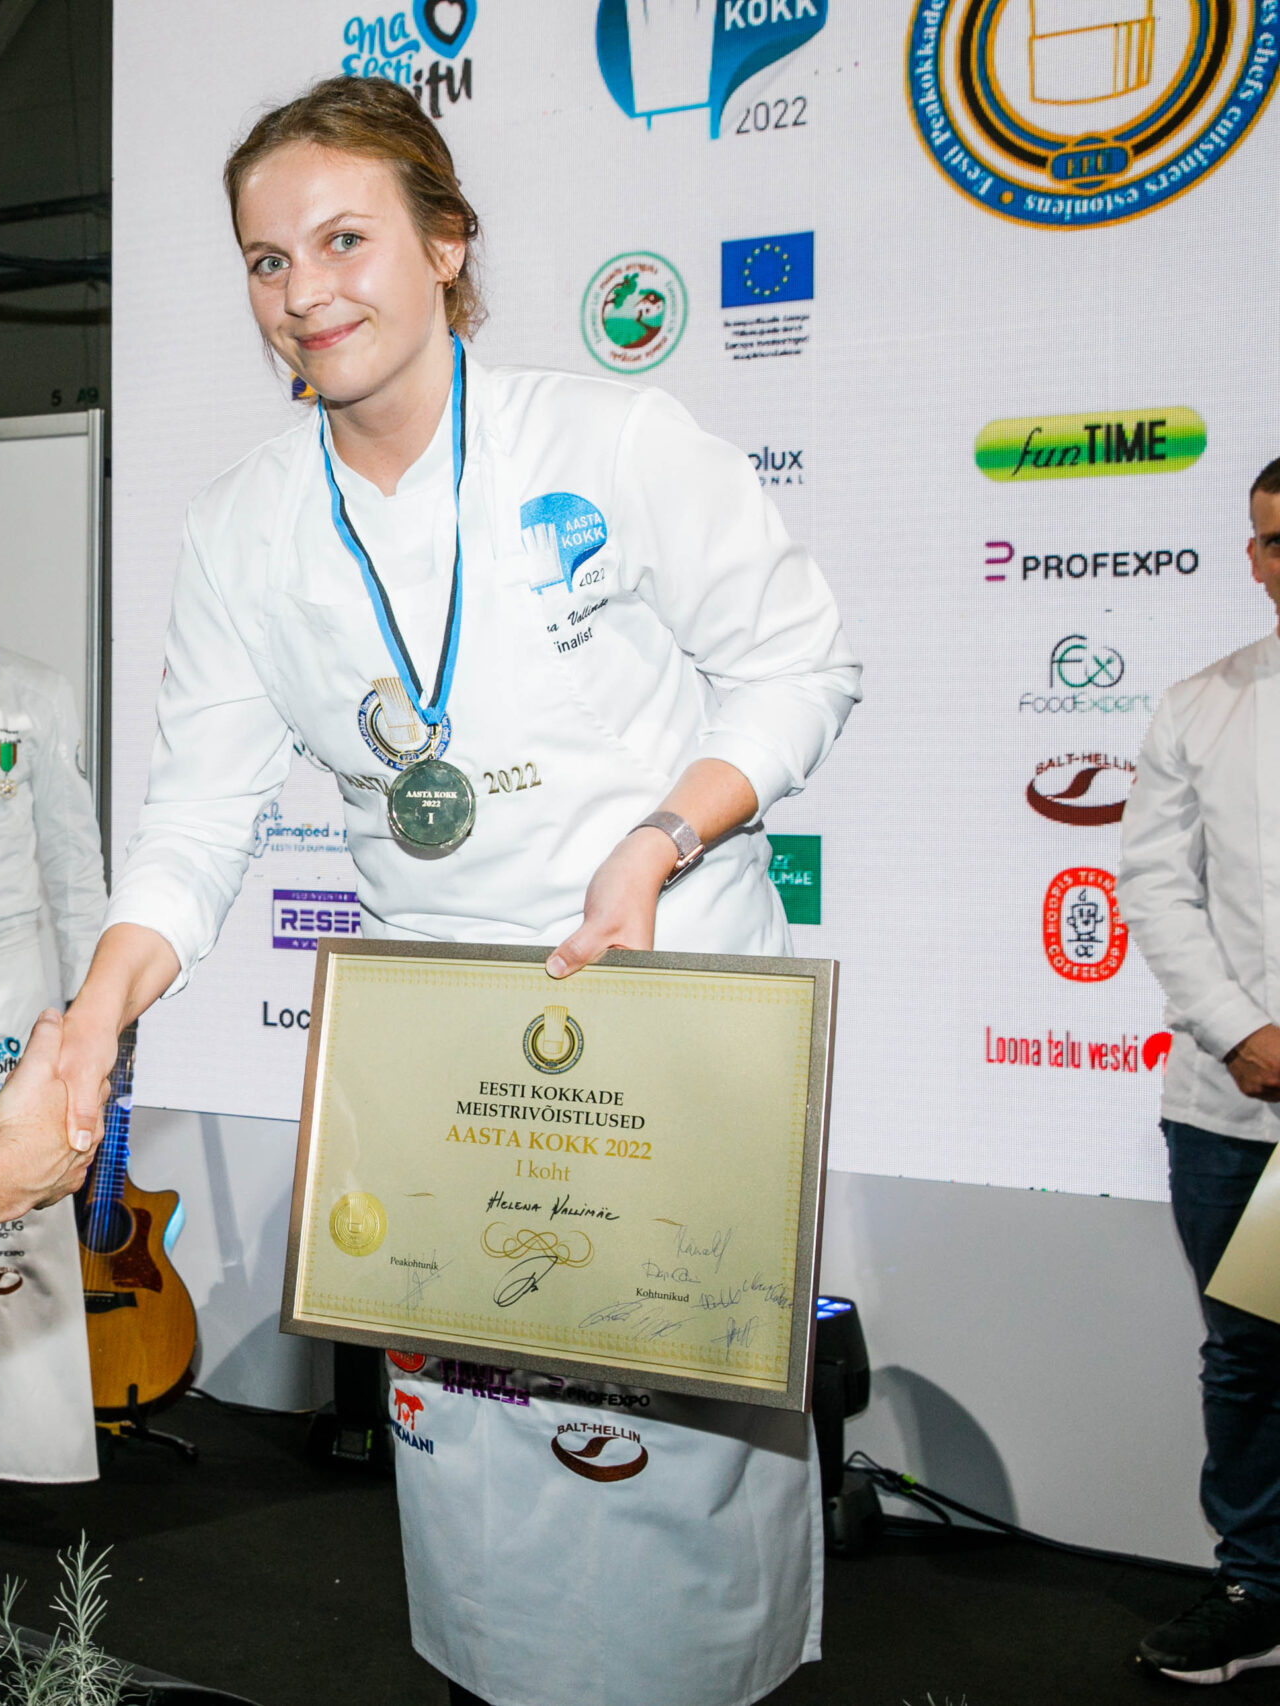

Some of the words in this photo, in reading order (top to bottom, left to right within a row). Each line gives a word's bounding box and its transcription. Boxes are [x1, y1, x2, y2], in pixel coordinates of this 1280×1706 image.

[724, 0, 817, 31] KOKK
[343, 12, 420, 58] Ma
[1239, 31, 1277, 101] chefs
[735, 96, 808, 135] 2022
[1023, 187, 1139, 222] estoniens
[565, 511, 603, 532] AASTA
[561, 526, 606, 550] KOKK
[1022, 549, 1200, 581] PROFEXPO
[553, 626, 594, 654] inalist
[483, 761, 542, 795] 2022
[406, 790, 432, 799] AASTA
[434, 791, 458, 799] KOKK
[422, 800, 441, 808] 2022
[986, 1026, 1042, 1067] Loona
[1048, 1029, 1081, 1069] talu
[1088, 1033, 1139, 1073] veski
[479, 1081, 526, 1099] EESTI
[530, 1086, 625, 1107] KOKKADE
[456, 1100, 646, 1130] MEISTRIVÕISTLUSED
[445, 1124, 522, 1149] AASTA
[528, 1133, 599, 1156] KOKK
[604, 1139, 653, 1161] 2022
[528, 1160, 572, 1183] koht
[390, 1256, 439, 1270] Peakohtunik
[635, 1286, 690, 1303] Kohtunikud
[557, 1422, 641, 1444] BALT-HELLIN
